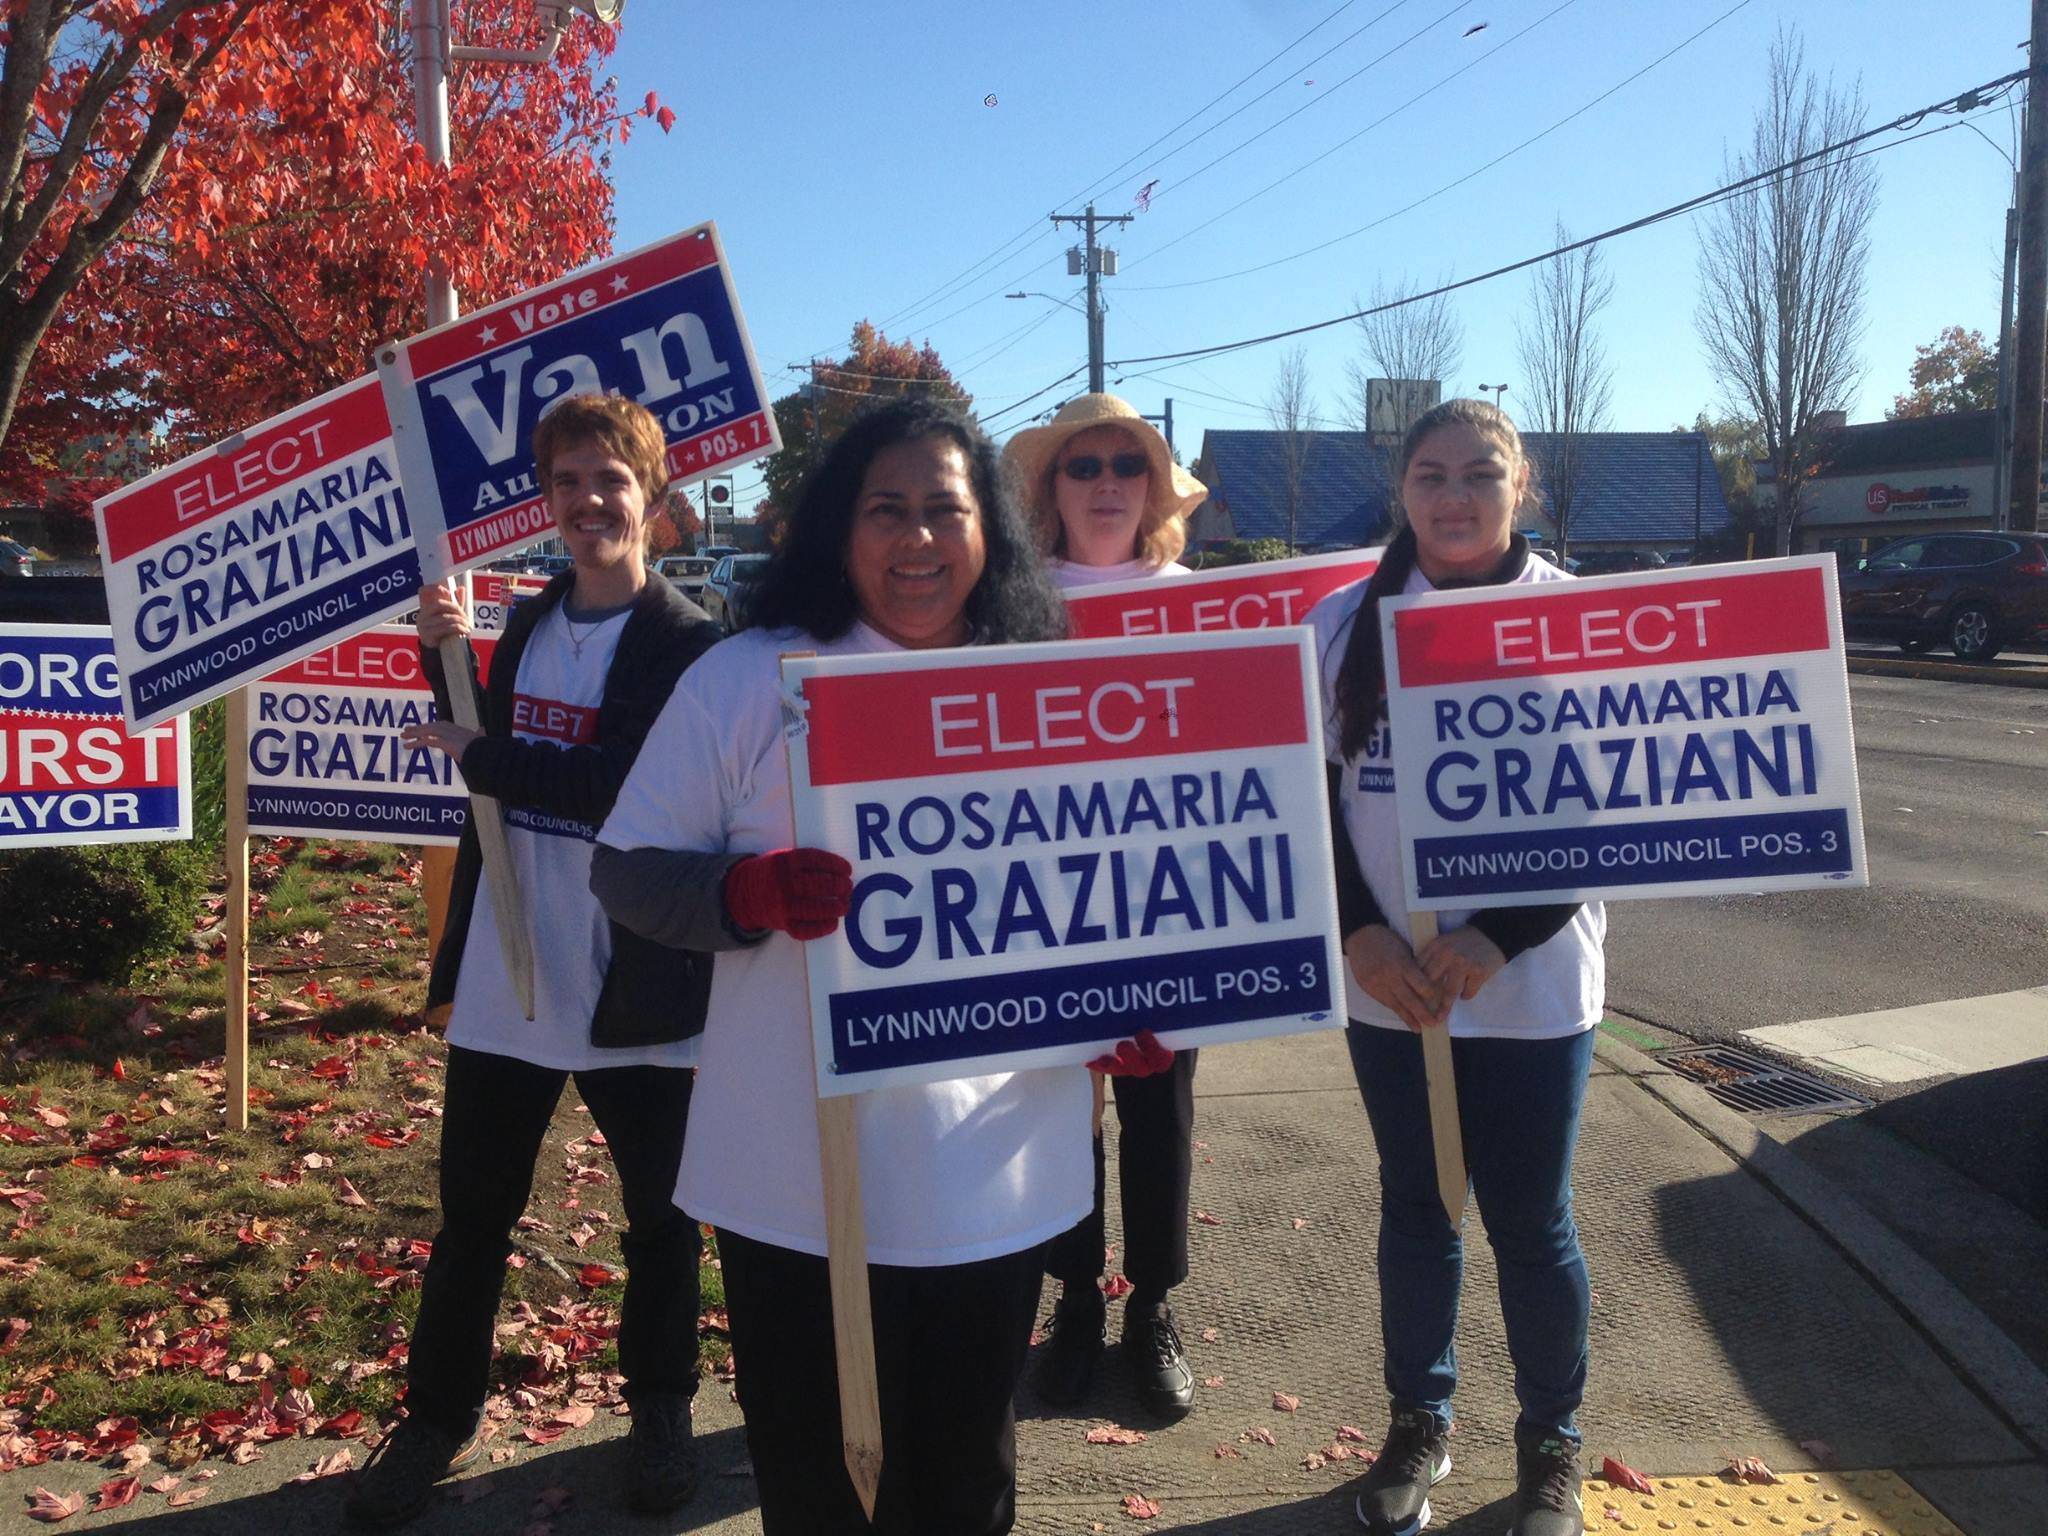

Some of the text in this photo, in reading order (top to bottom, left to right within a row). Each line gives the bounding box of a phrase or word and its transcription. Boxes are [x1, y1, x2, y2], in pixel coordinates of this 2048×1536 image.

[511, 287, 598, 334] Vote
[430, 311, 730, 467] Van
[173, 419, 331, 522] ELECT
[700, 420, 760, 462] POS. 7
[136, 456, 392, 595] ROSAMARIA
[135, 487, 411, 653] GRAZIANI
[140, 570, 412, 702] LYNNWOOD COUNCIL POS.
[303, 646, 420, 681] ELEC
[1494, 599, 1722, 667] ELECT
[0, 653, 122, 698] ORG
[1435, 669, 1800, 742] ROSAMARIA
[930, 677, 1195, 758] ELECT
[0, 793, 139, 829] AYOR
[1425, 723, 1818, 822] GRAZIANI
[355, 804, 435, 823] COUNCIL
[441, 809, 465, 824] PO
[855, 767, 1278, 861] ROSAMARIA
[1427, 830, 1838, 879] LYNNWOOD COUNCIL POS. 3
[844, 832, 1296, 969] GRAZIANI
[846, 963, 1317, 1047] LYNNWOOD COUNCIL POS. 3
